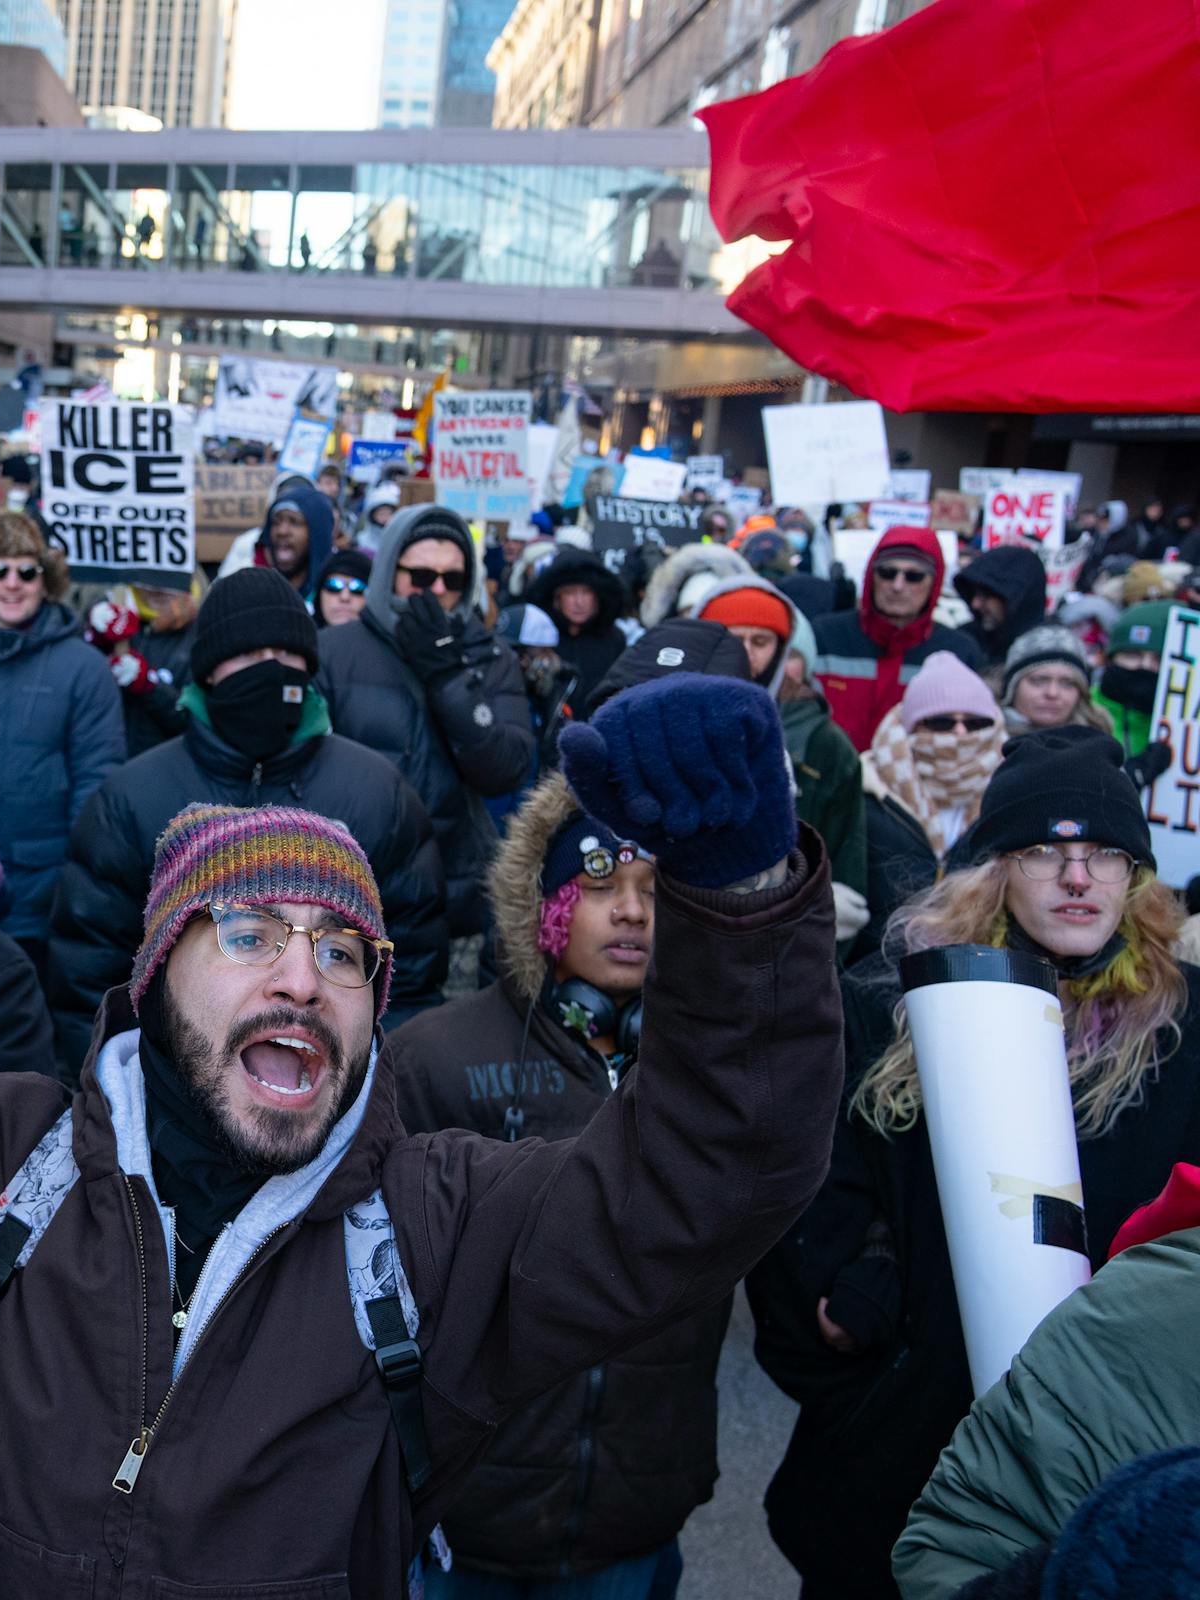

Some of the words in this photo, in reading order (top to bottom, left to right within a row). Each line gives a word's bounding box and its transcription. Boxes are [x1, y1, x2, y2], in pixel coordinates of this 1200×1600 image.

[58, 404, 173, 452] KILLER
[50, 450, 186, 494] ICE
[439, 451, 525, 479] HATEFUL
[52, 502, 111, 520] OFF
[119, 506, 187, 523] OUR
[596, 496, 702, 530] HISTORY
[991, 492, 1056, 519] ONE
[51, 521, 188, 566] STREETS
